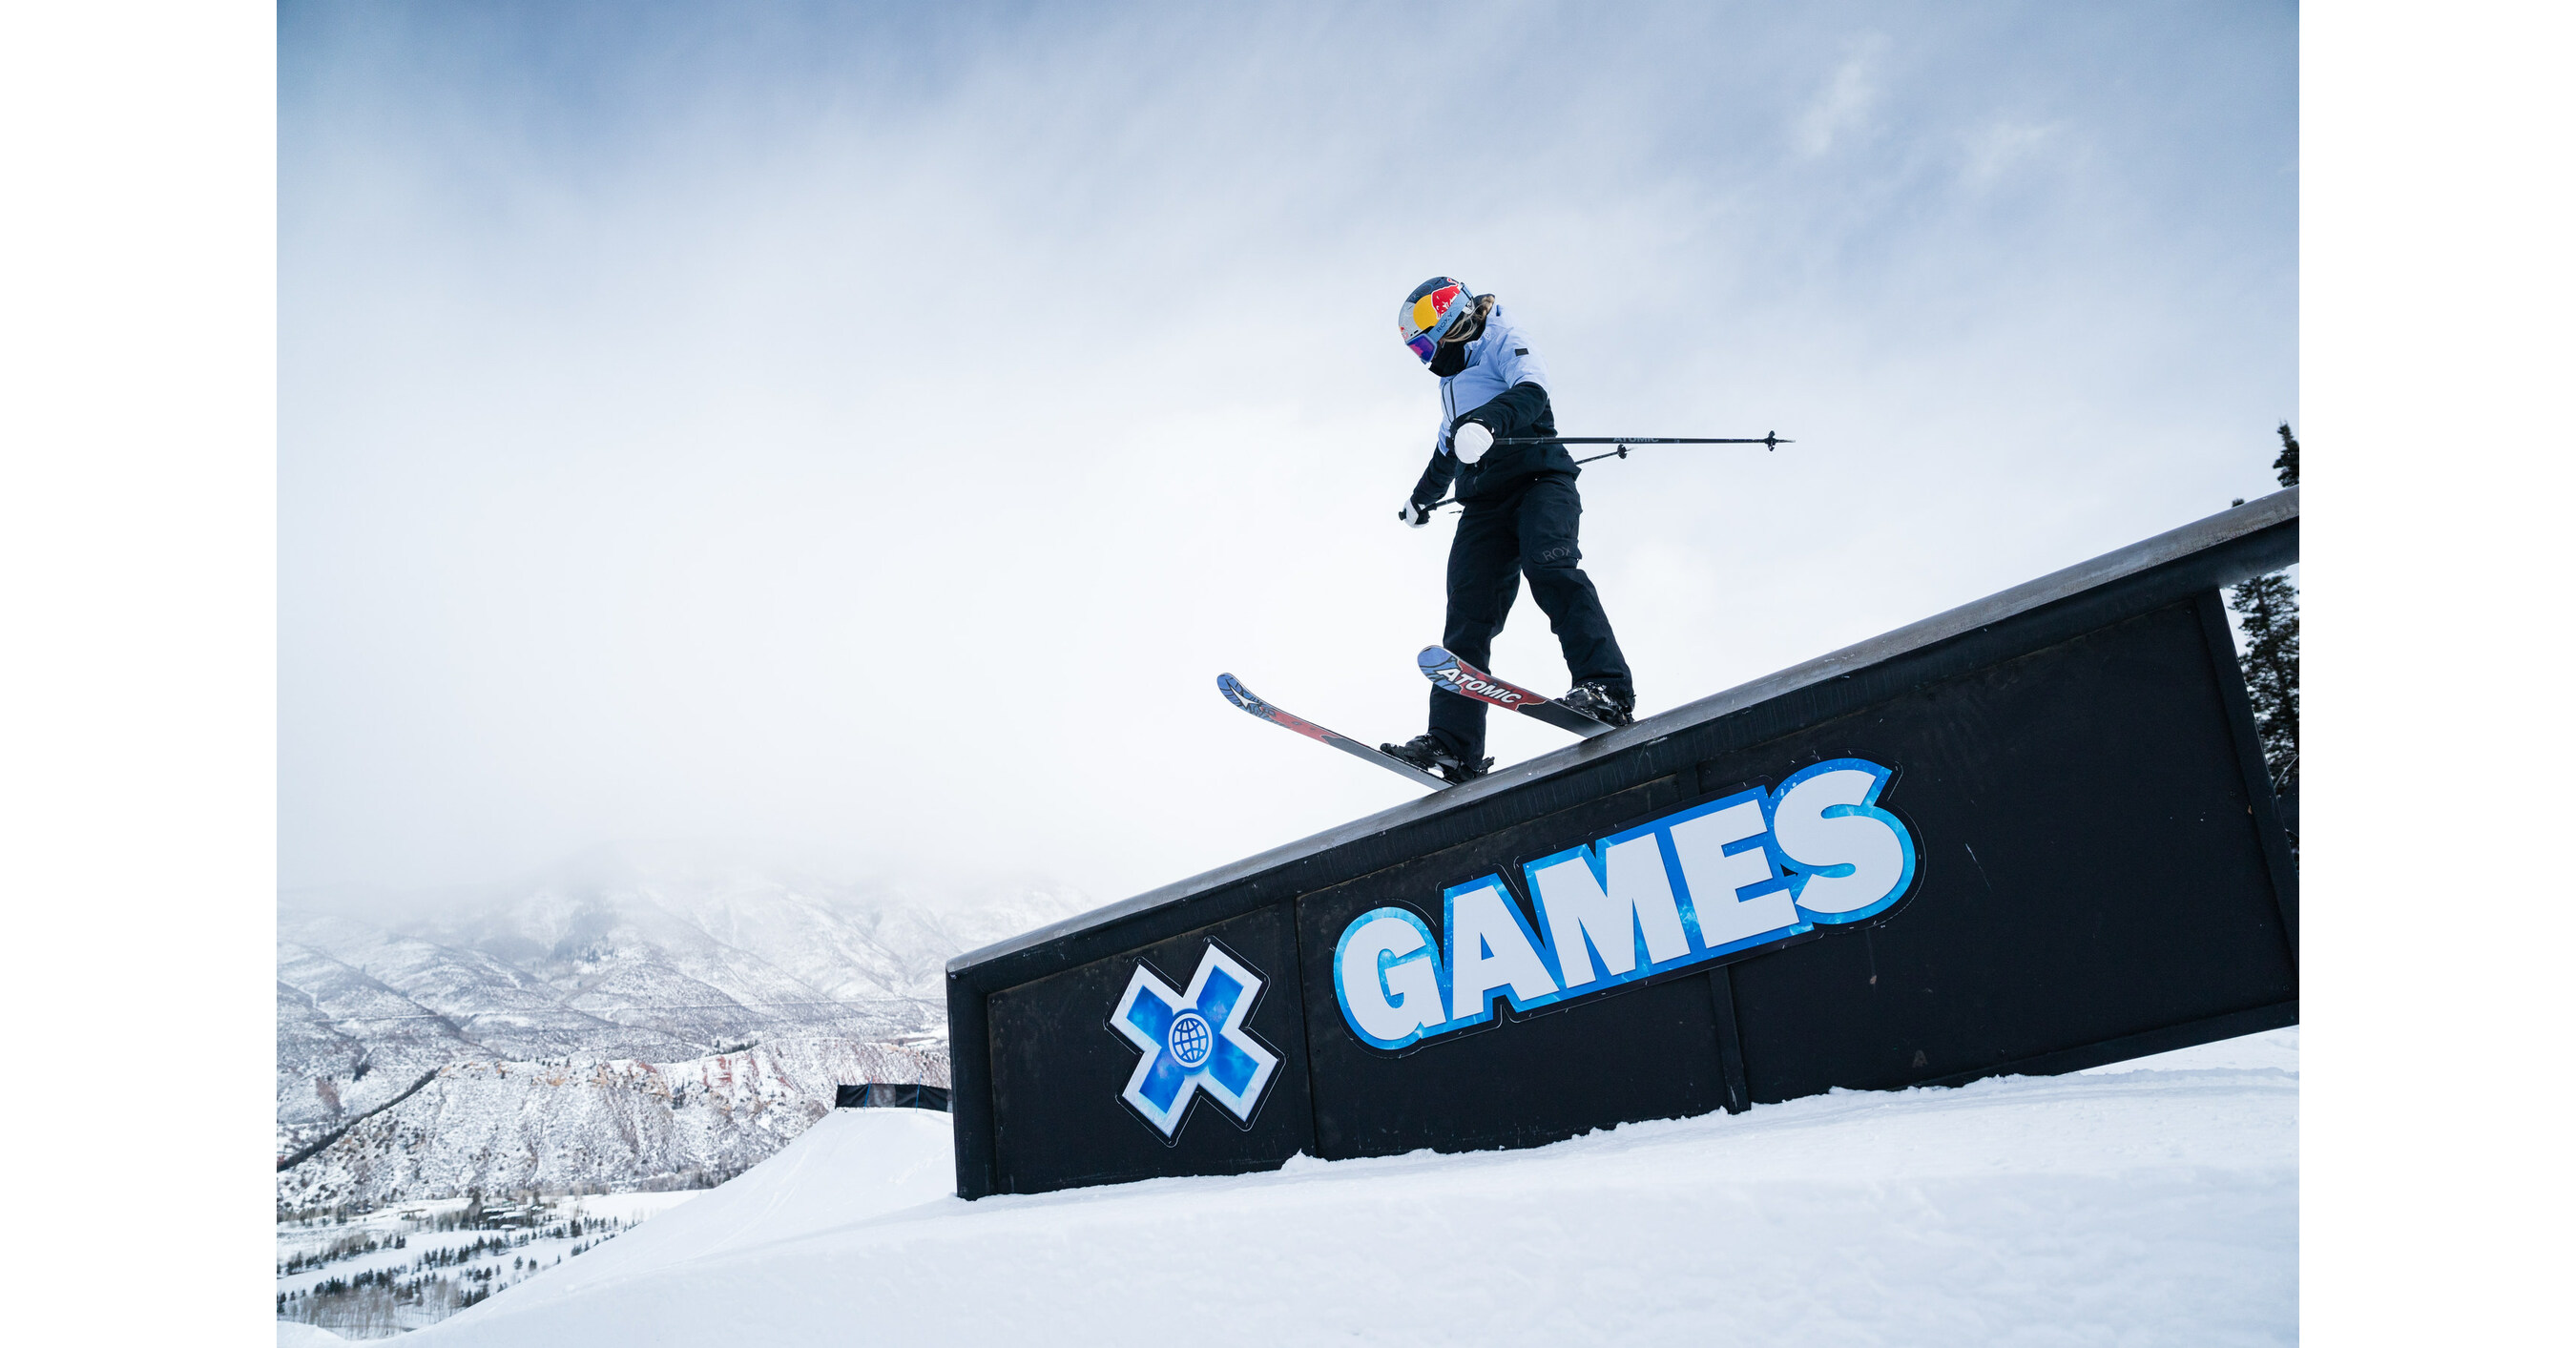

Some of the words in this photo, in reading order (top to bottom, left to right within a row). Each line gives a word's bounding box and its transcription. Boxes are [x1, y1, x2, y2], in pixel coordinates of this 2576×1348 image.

[1436, 312, 1453, 333] ROXY
[1542, 546, 1572, 561] ROX
[1435, 668, 1523, 704] ATOMIC
[1338, 760, 1911, 1048] GAMES
